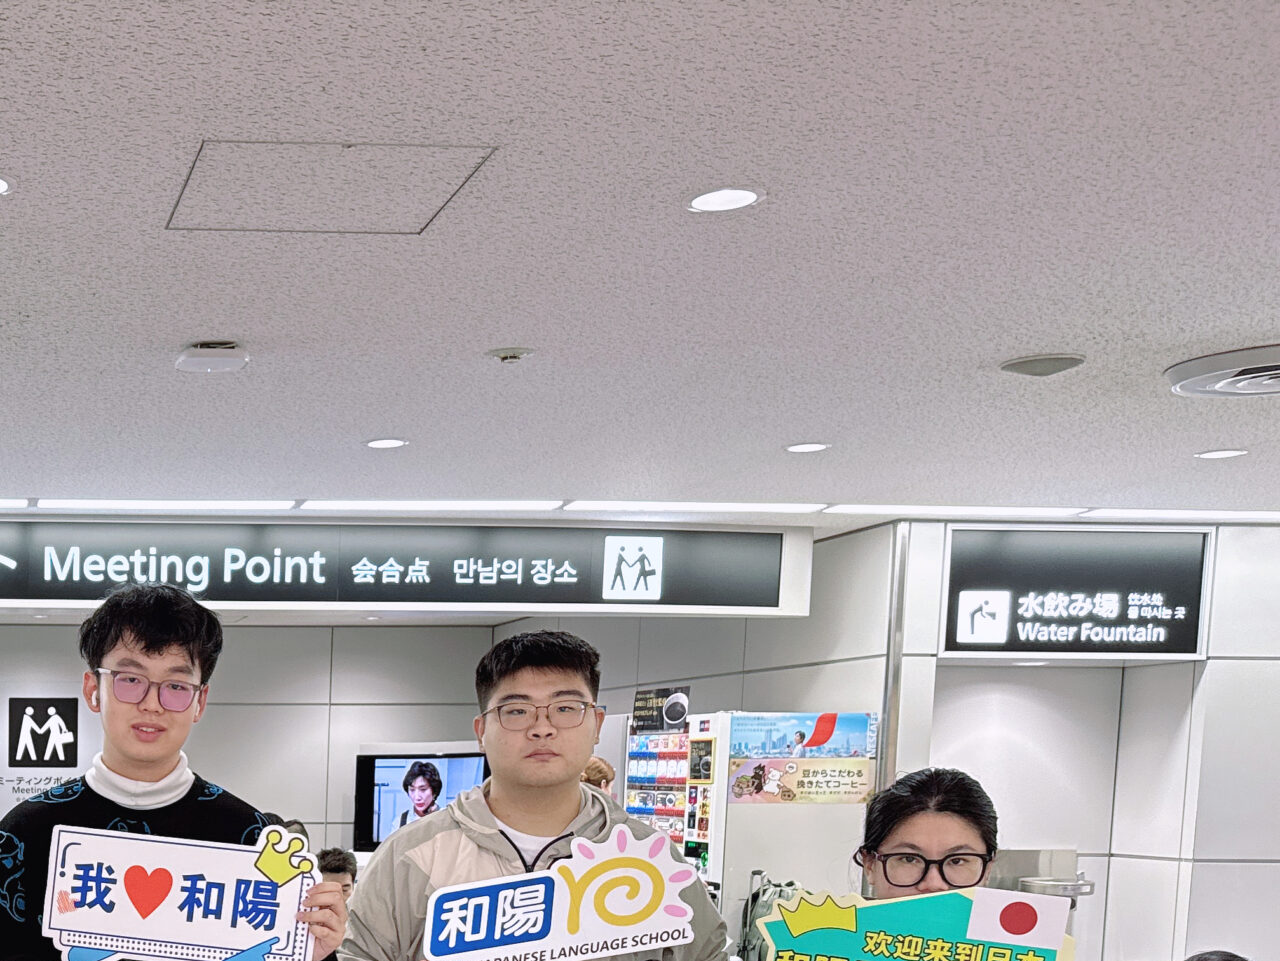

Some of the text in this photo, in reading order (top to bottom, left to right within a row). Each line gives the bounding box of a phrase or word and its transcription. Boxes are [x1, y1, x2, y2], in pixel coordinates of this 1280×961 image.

[43, 546, 326, 592] Meeting Point
[351, 556, 431, 585] 会合点
[453, 557, 578, 585] 만남의 장소
[1018, 591, 1119, 619] 水飲み場
[1017, 622, 1166, 643] Water Fountain
[802, 769, 864, 778] 豆からこだわる
[71, 862, 280, 931] 我 和陽
[437, 882, 546, 948] 和陽
[549, 938, 629, 960] LANGUAGE
[631, 928, 690, 948] SCHOOL
